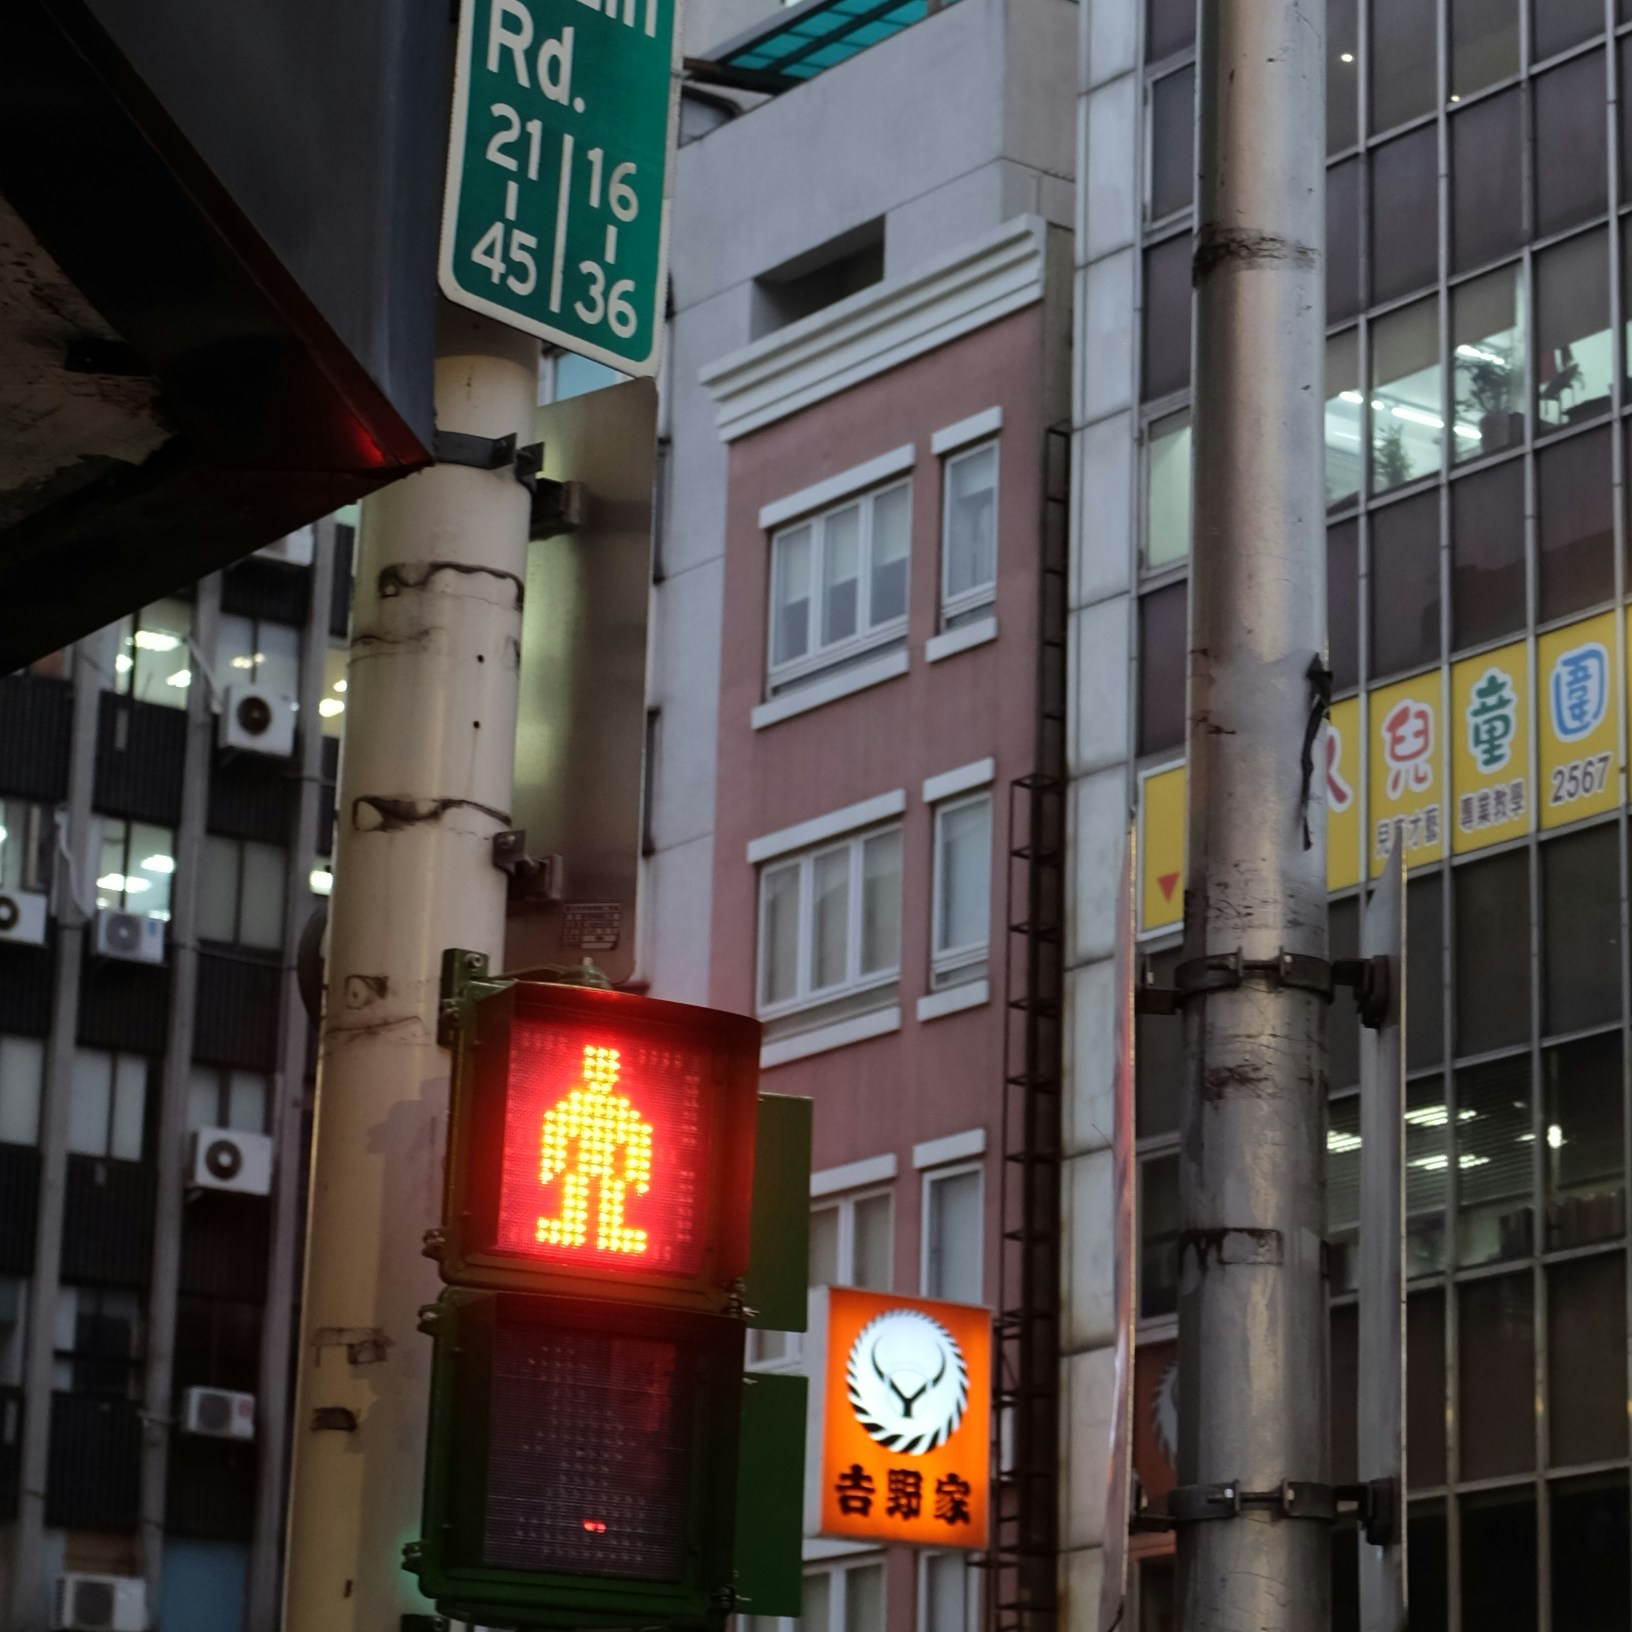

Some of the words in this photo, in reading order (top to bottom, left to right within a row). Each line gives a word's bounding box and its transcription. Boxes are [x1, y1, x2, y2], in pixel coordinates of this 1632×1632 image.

[486, 101, 540, 182] 21
[586, 146, 640, 224] 16
[469, 220, 537, 300] 45
[575, 260, 639, 338] 36
[1550, 756, 1611, 809] 2567
